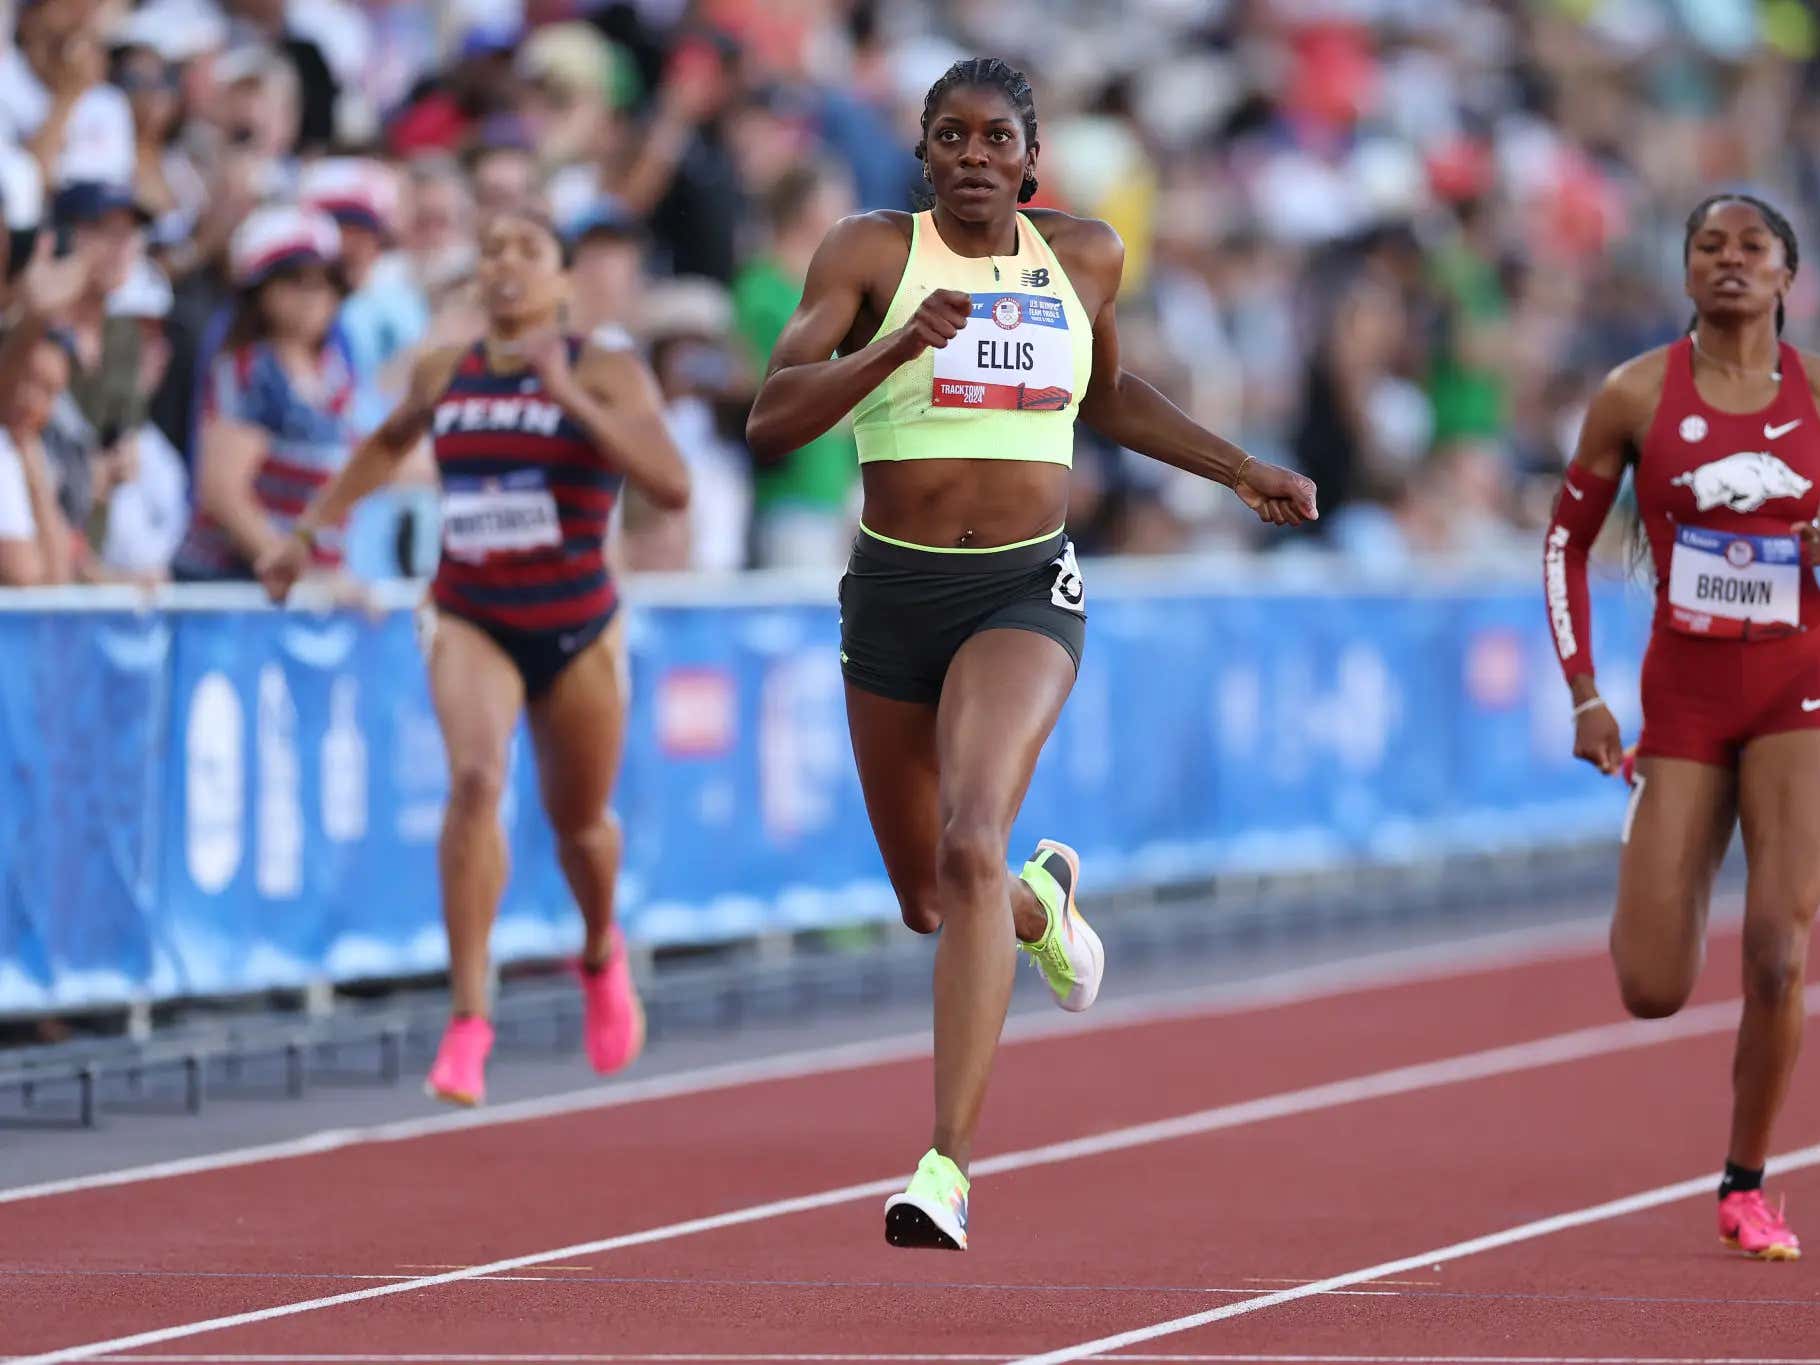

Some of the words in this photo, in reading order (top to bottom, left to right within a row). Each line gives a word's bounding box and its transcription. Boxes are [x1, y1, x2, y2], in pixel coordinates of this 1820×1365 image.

[977, 340, 1034, 371] ELLIS
[963, 393, 983, 404] 2024
[1697, 574, 1773, 605] BROWN
